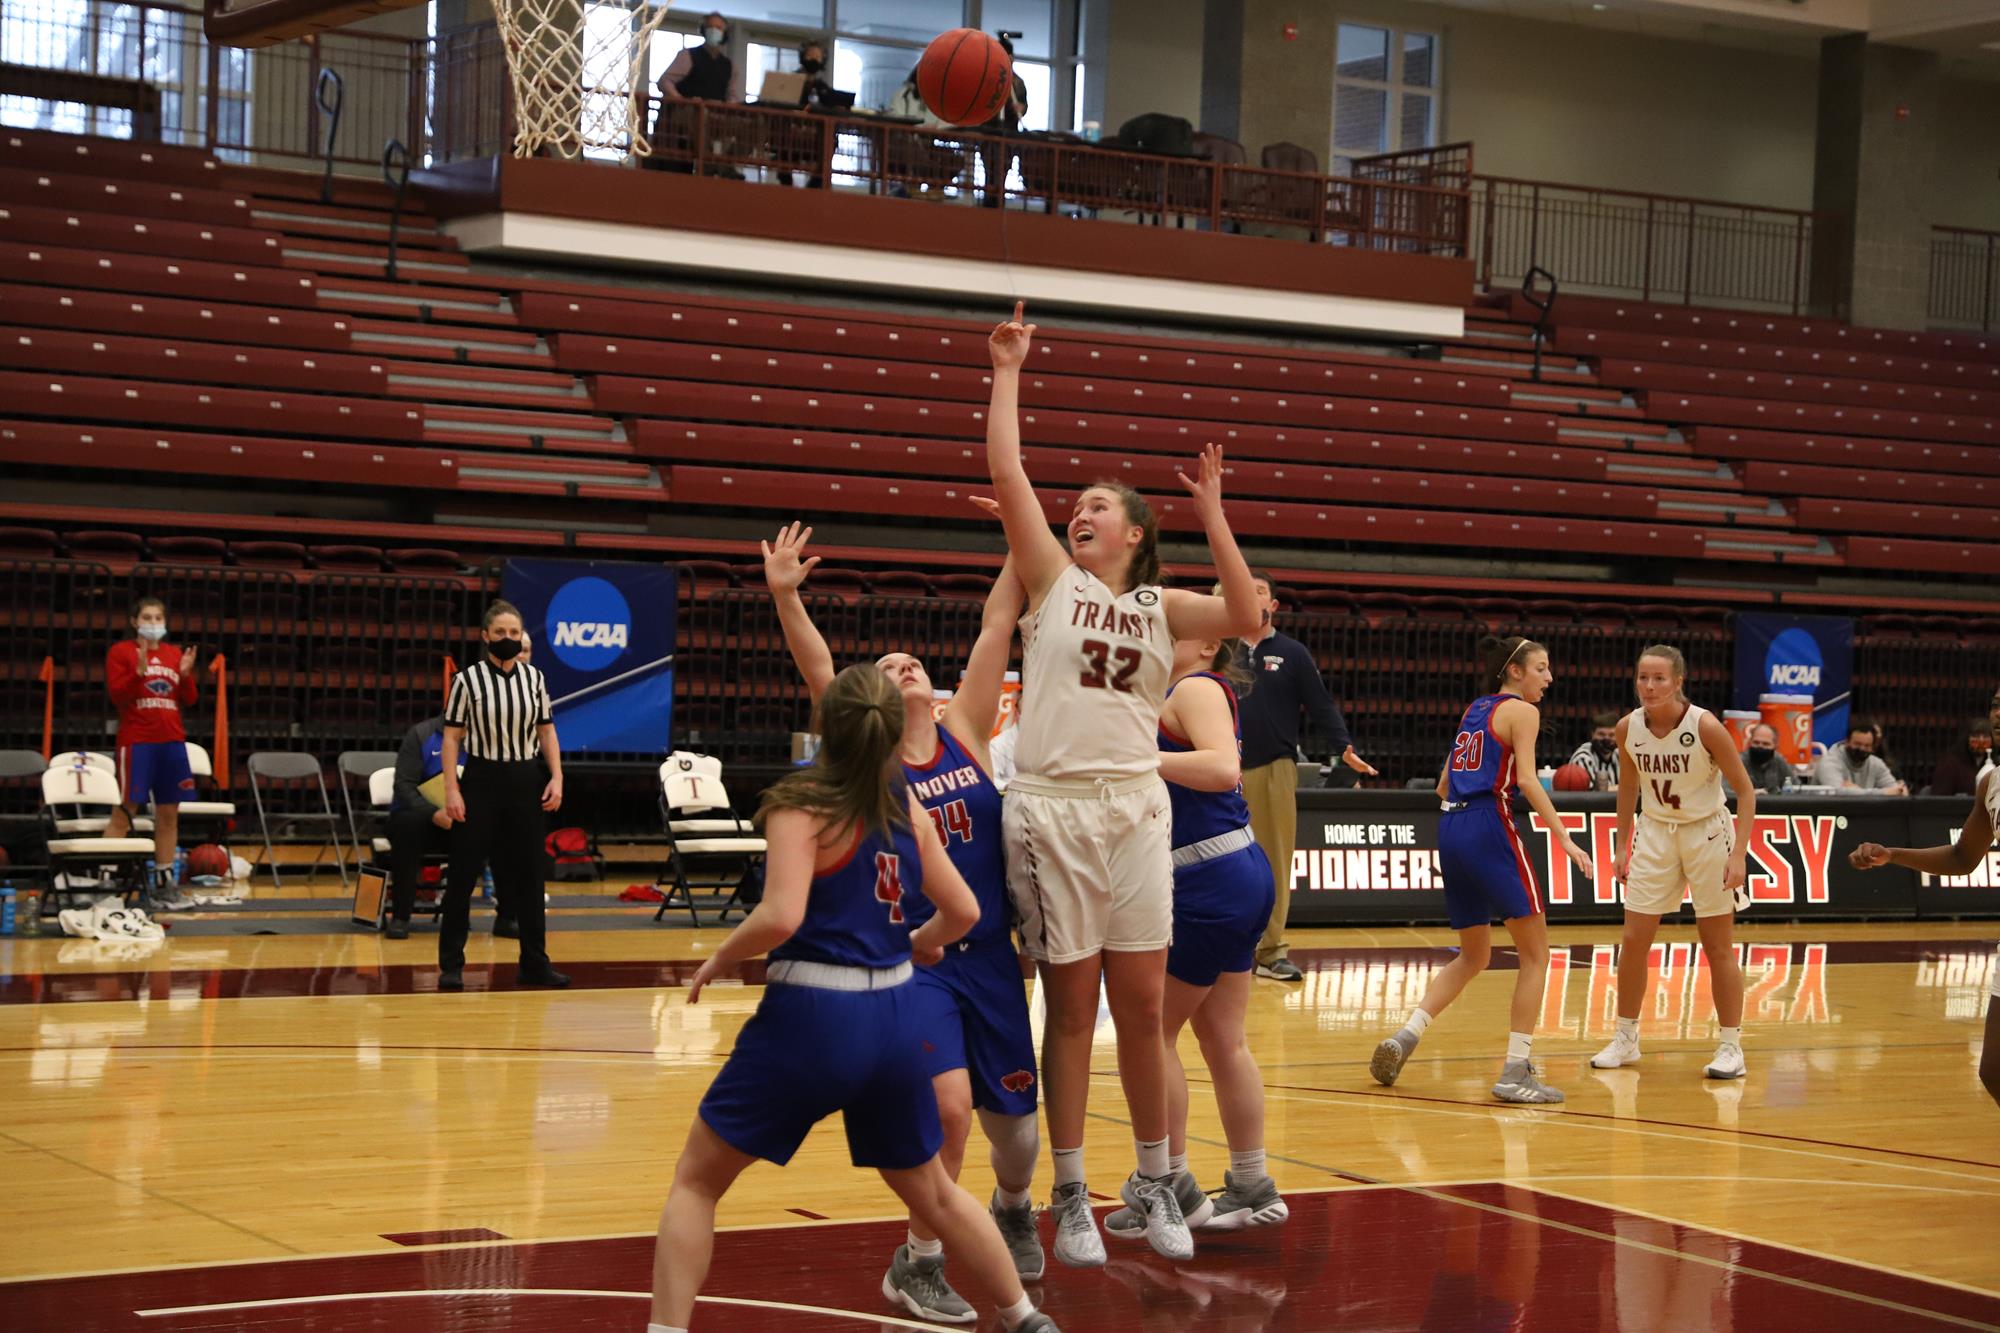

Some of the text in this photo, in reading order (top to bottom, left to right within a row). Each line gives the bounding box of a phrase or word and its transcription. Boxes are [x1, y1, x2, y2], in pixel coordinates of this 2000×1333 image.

[553, 621, 627, 648] NCAA
[1080, 638, 1142, 694] 32
[1770, 664, 1820, 686] NCAA
[1452, 730, 1484, 772] 20
[1635, 753, 1690, 773] TRANSY
[914, 765, 980, 801] NOVER
[1650, 779, 1681, 810] 14
[1324, 824, 1416, 844] HOME OF THE
[874, 851, 905, 924] 4
